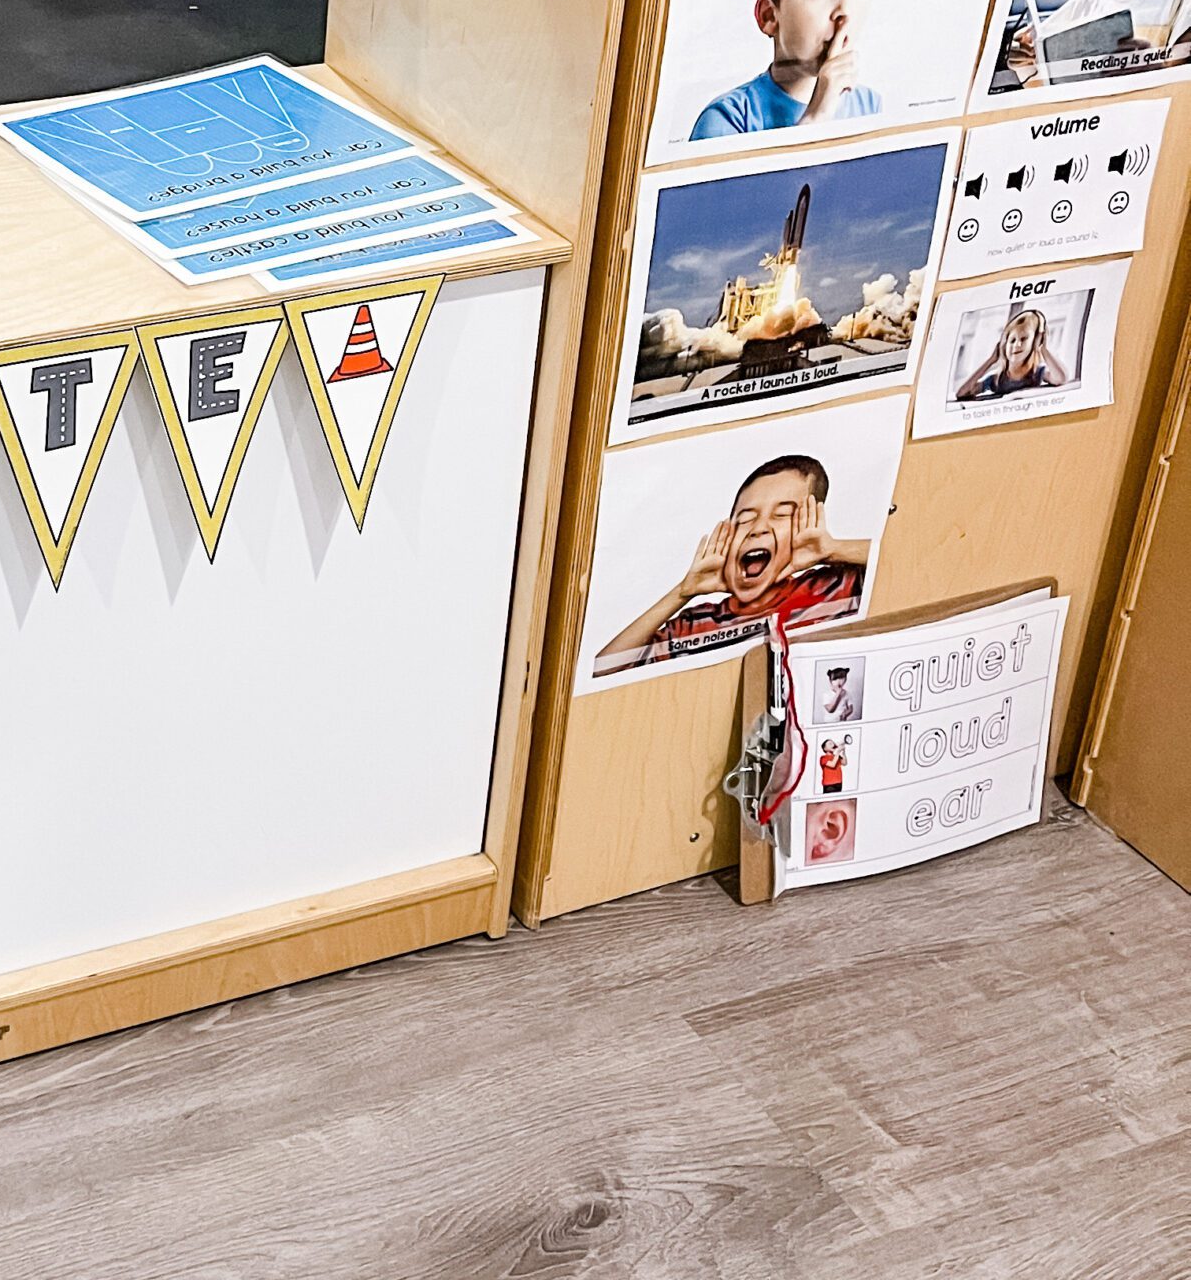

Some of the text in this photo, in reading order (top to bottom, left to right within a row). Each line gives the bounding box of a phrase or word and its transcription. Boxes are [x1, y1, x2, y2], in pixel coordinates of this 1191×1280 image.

[1080, 54, 1128, 71] Reading
[1130, 53, 1142, 64] is
[1030, 114, 1101, 140] volume
[148, 138, 384, 203] Can you build a bridge?
[384, 176, 427, 191] Can
[285, 195, 340, 214] build
[342, 186, 380, 201] you
[185, 211, 264, 238] house?
[265, 207, 282, 217] a
[209, 201, 460, 263] Can you build a castle?
[1008, 278, 1057, 300] hear
[701, 365, 839, 400] A rocket launch is loud.
[668, 638, 700, 652] Some
[703, 628, 739, 645] noises
[742, 622, 762, 634] are
[888, 622, 1032, 713] quiet
[897, 696, 1013, 773] loud
[905, 778, 993, 837] ear
